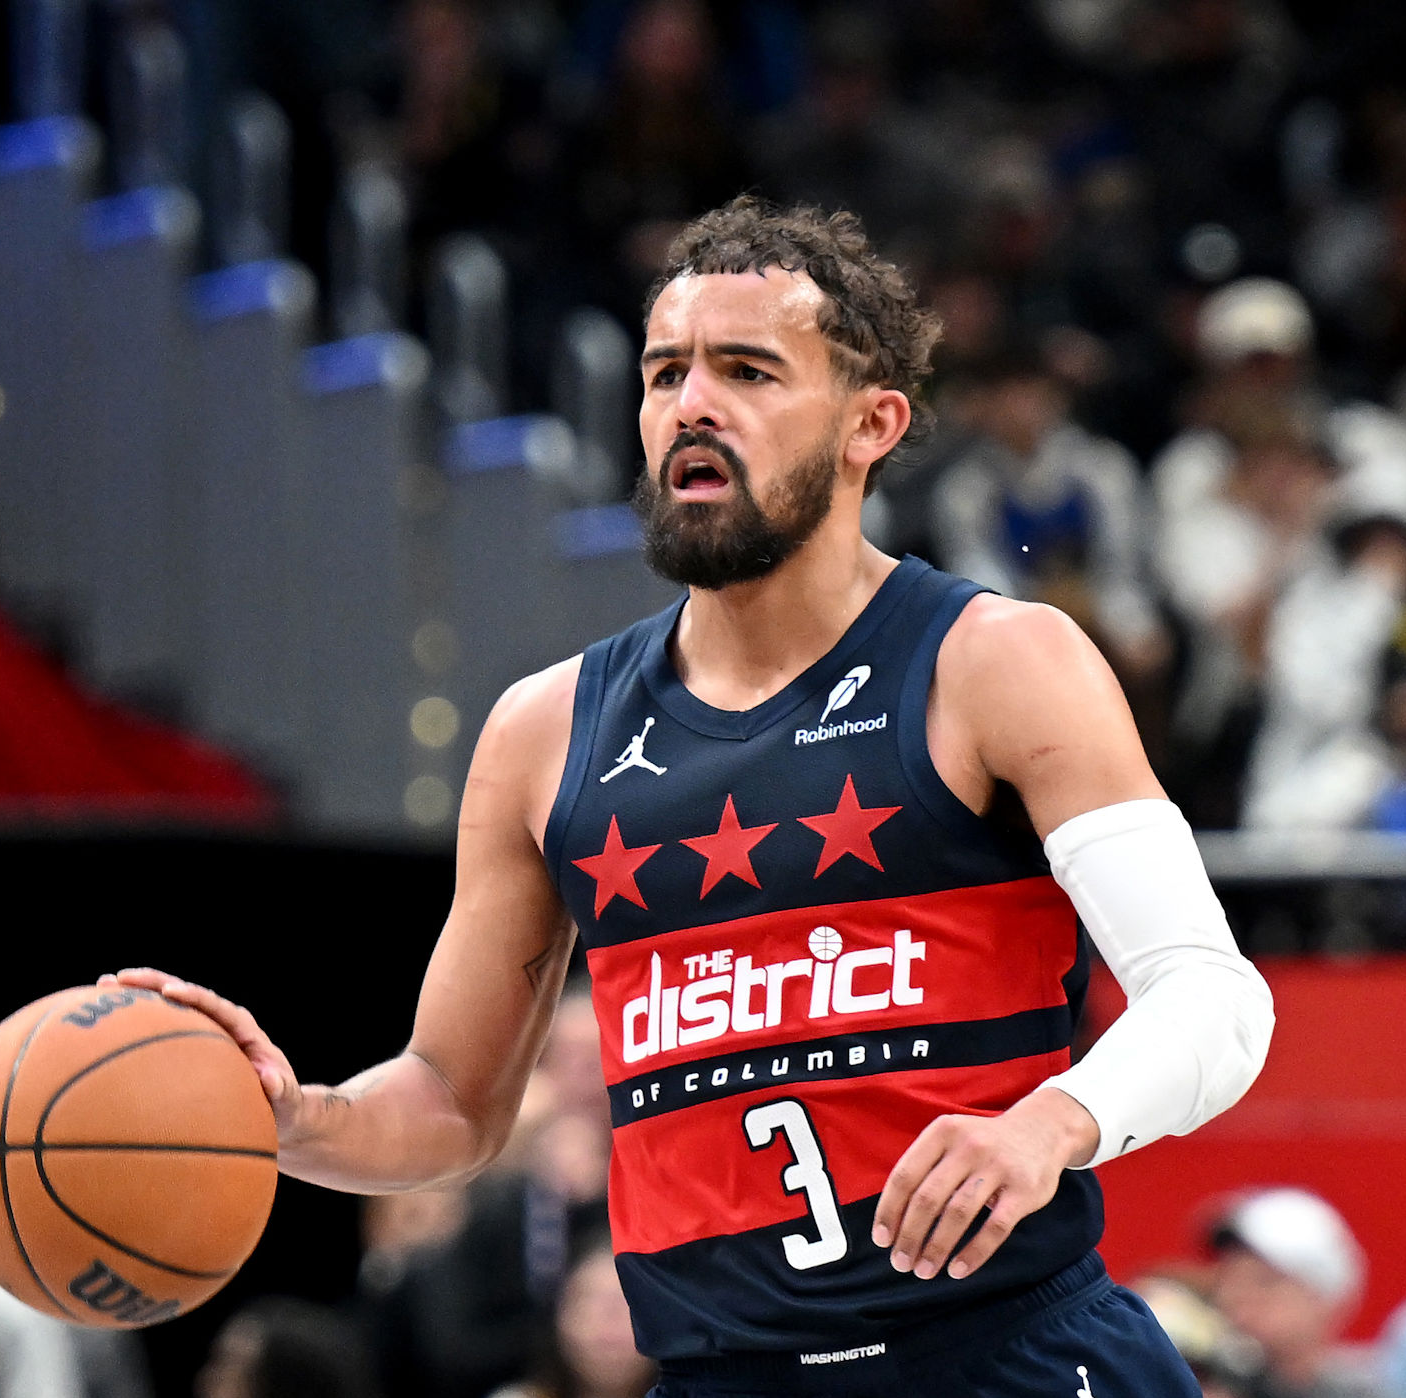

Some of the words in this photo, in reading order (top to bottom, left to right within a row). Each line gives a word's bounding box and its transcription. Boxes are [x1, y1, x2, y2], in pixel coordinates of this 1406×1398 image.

[794, 712, 887, 745] Robinhood
[683, 948, 734, 980] THE
[622, 925, 926, 1064] district
[631, 1082, 661, 1108] OF
[684, 1039, 930, 1092] COLUMBIA
[743, 1100, 849, 1271] 3
[800, 1343, 886, 1365] WASHINGTON
